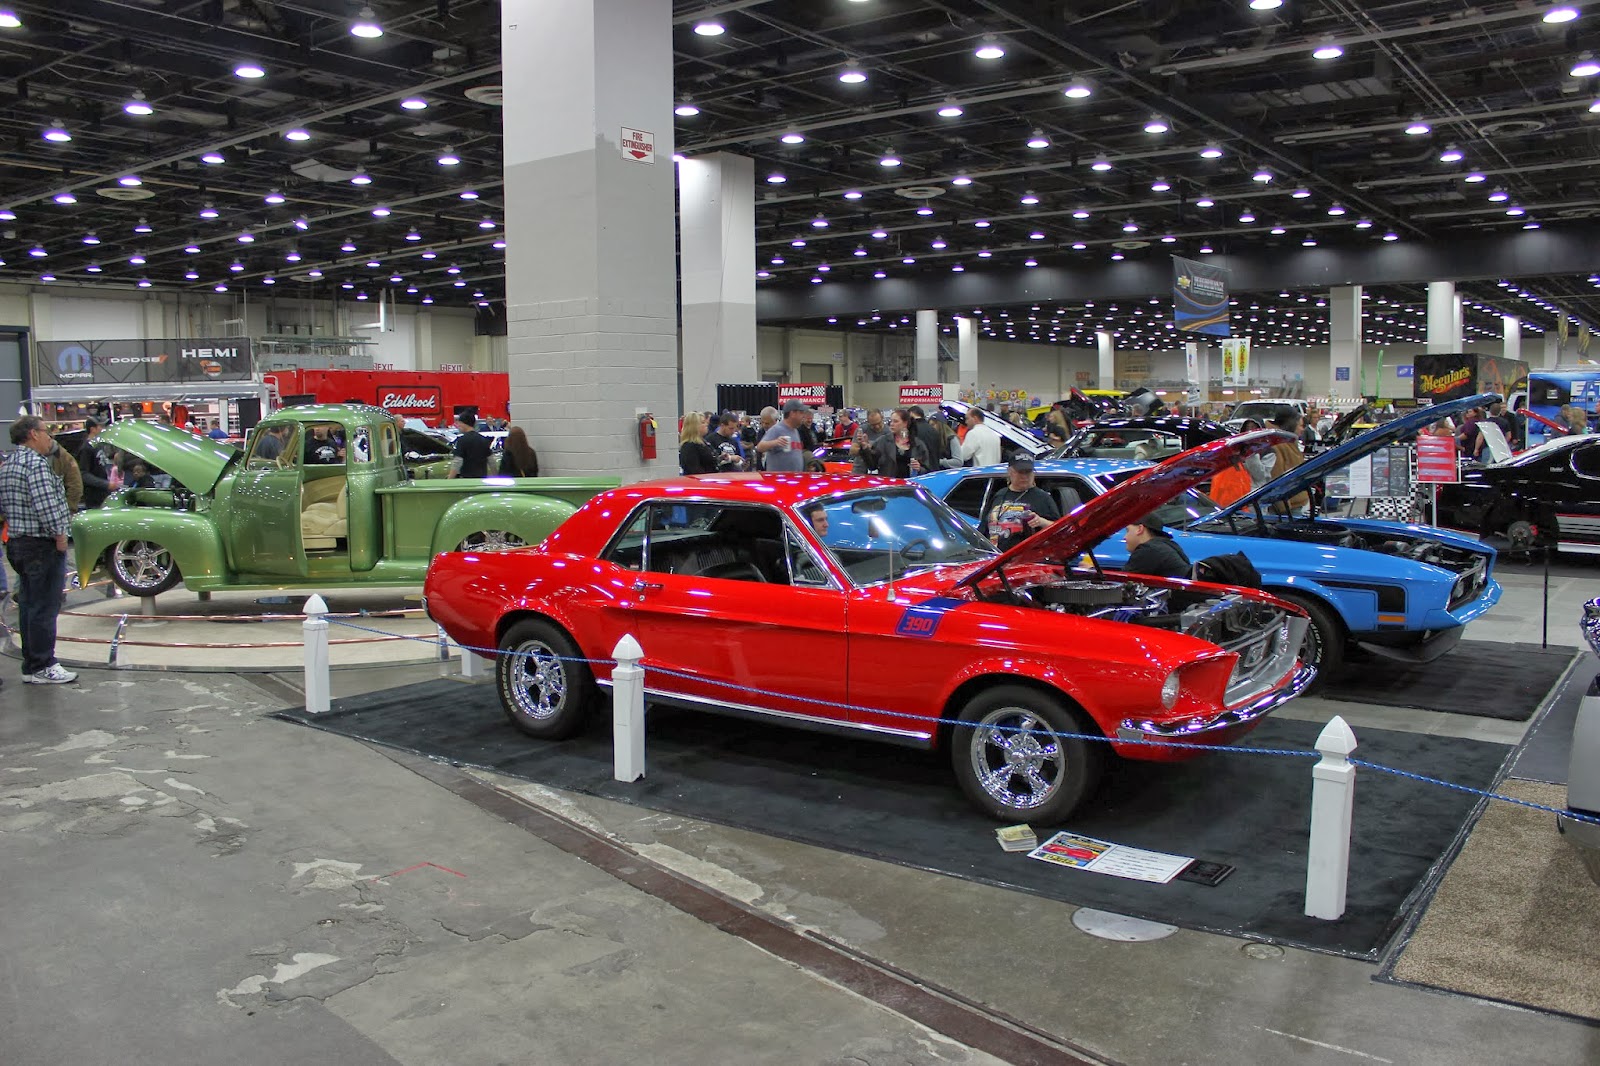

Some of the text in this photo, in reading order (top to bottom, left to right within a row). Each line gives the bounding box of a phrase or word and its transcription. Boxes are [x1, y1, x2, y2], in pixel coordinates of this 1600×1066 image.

[632, 132, 643, 141] FIRE
[622, 138, 653, 152] EXTINGUISHER
[181, 348, 238, 358] HEMI
[378, 363, 394, 371] EXIT
[447, 364, 463, 372] EXIT
[1420, 366, 1470, 394] Meguiar's
[781, 386, 812, 397] MARCH
[901, 387, 930, 397] MARCH
[382, 393, 436, 409] Edelbrock
[903, 616, 934, 632] 390
